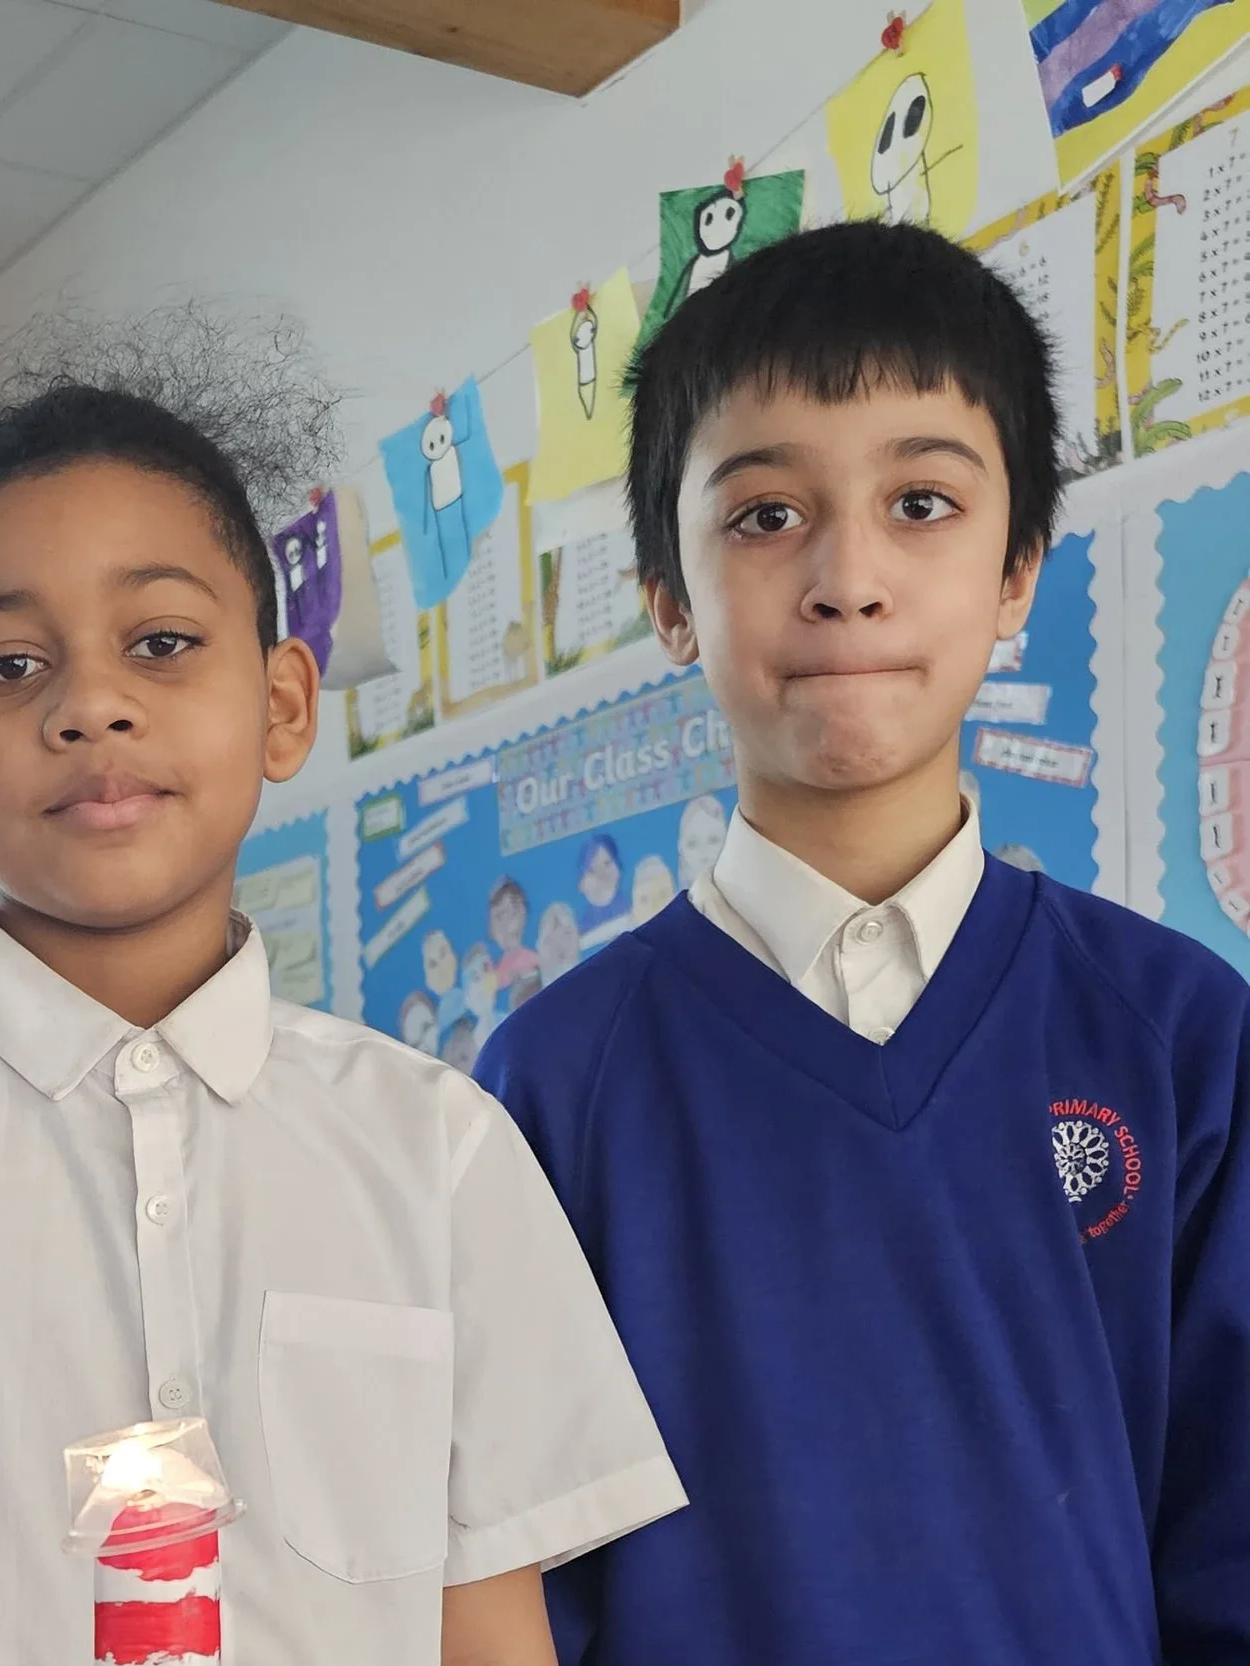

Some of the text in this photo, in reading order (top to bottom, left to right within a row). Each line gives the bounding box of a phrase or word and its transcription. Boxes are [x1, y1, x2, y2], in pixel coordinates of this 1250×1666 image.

[516, 773, 574, 814] Our
[584, 738, 670, 790] Class
[1049, 1099, 1142, 1195] RIMARY SCHOOL
